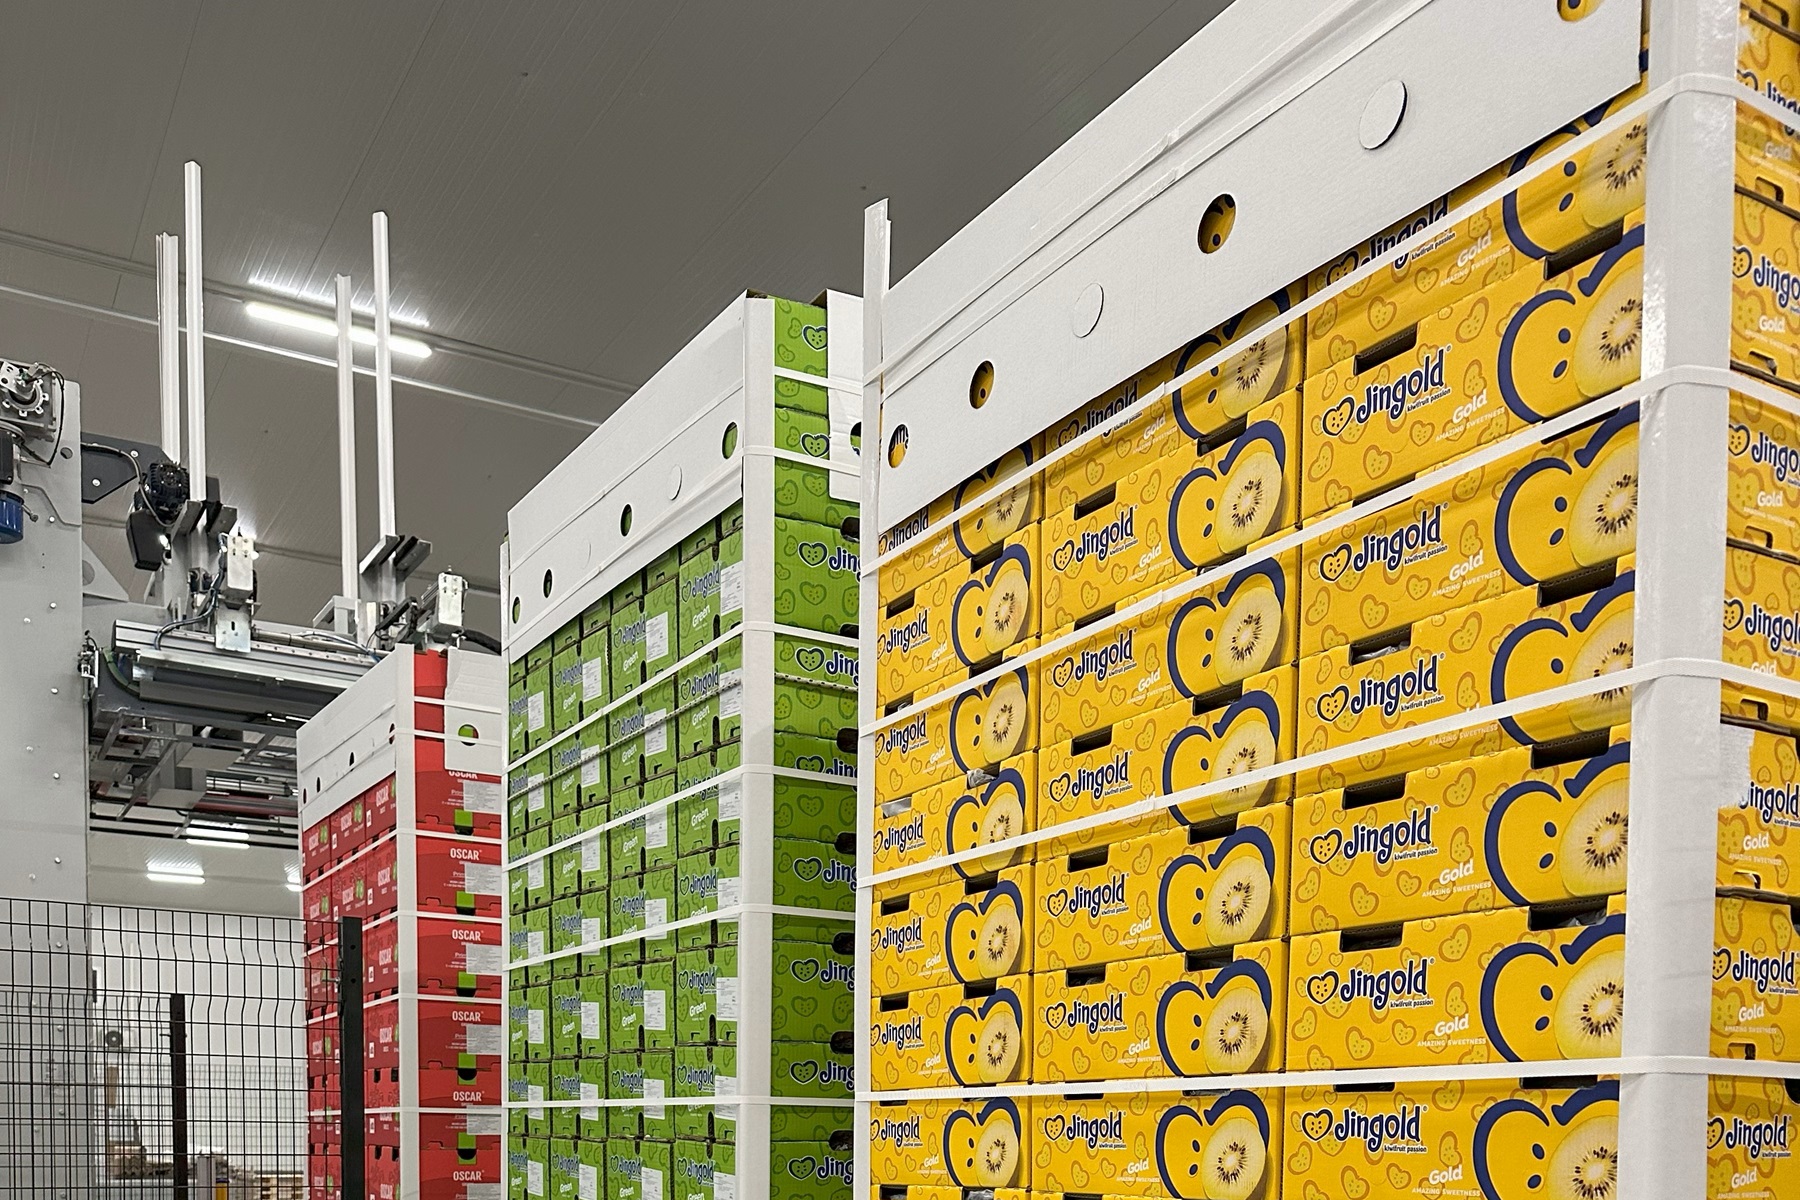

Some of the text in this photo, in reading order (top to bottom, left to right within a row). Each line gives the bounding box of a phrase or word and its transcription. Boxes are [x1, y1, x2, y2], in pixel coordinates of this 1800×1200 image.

[1458, 231, 1492, 268] Gold
[1759, 316, 1785, 332] Gold
[1356, 349, 1444, 424] Jingold
[1430, 387, 1451, 405] passion
[1452, 390, 1488, 424] Gold
[1144, 414, 1166, 440] Gold
[1435, 407, 1506, 443] AMAZING SWEETNESS
[1757, 492, 1783, 507] Gold
[1076, 508, 1135, 561] Jingold
[1353, 509, 1441, 571] Jingold
[1140, 545, 1162, 568] Gold
[1427, 545, 1448, 560] passion
[1449, 550, 1484, 582] Gold
[1432, 569, 1502, 598] AMAZING SWEETNESS
[886, 609, 928, 653] Jingold
[1076, 633, 1132, 682] Jingold
[1138, 670, 1160, 692] Gold
[1351, 659, 1438, 717] Jingold
[1424, 695, 1444, 707] passion
[886, 715, 926, 753] Jingold
[1072, 754, 1129, 800] Jingold
[884, 815, 923, 852] Jingold
[1344, 808, 1432, 864] Jingold
[1743, 833, 1769, 851] Gold
[450, 848, 479, 860] OSCAR
[1417, 847, 1438, 858] passion
[1439, 860, 1474, 886] Gold
[1070, 874, 1125, 918] Jingold
[1422, 881, 1492, 898] AMAZING SWEETNESS
[452, 929, 481, 941] OSCAR
[882, 917, 922, 952] Jingold
[1130, 917, 1152, 936] Gold
[1733, 951, 1794, 992] Jingold
[1340, 959, 1428, 1011] Jingold
[690, 1001, 707, 1017] Green
[1068, 994, 1123, 1034] Jingold
[1413, 998, 1434, 1008] passion
[1739, 1004, 1764, 1021] Gold
[452, 1011, 481, 1021] OSCAR
[1434, 1014, 1469, 1038] Gold
[882, 1017, 921, 1049] Jingold
[1448, 1038, 1486, 1046] SWEETNESS
[1128, 1038, 1150, 1054] Gold
[453, 1091, 482, 1101] OSCAR
[881, 1116, 919, 1147] Jingold
[1066, 1112, 1122, 1149] Jingold
[1334, 1106, 1421, 1152] Jingold
[1726, 1115, 1787, 1159] Jingold
[1407, 1145, 1428, 1154] passion
[453, 1171, 482, 1181] OSCAR
[1128, 1159, 1149, 1174] Gold
[1429, 1165, 1463, 1186] Gold
[1731, 1168, 1757, 1188] Gold
[1412, 1188, 1481, 1197] AMAZING SWEETNESS
